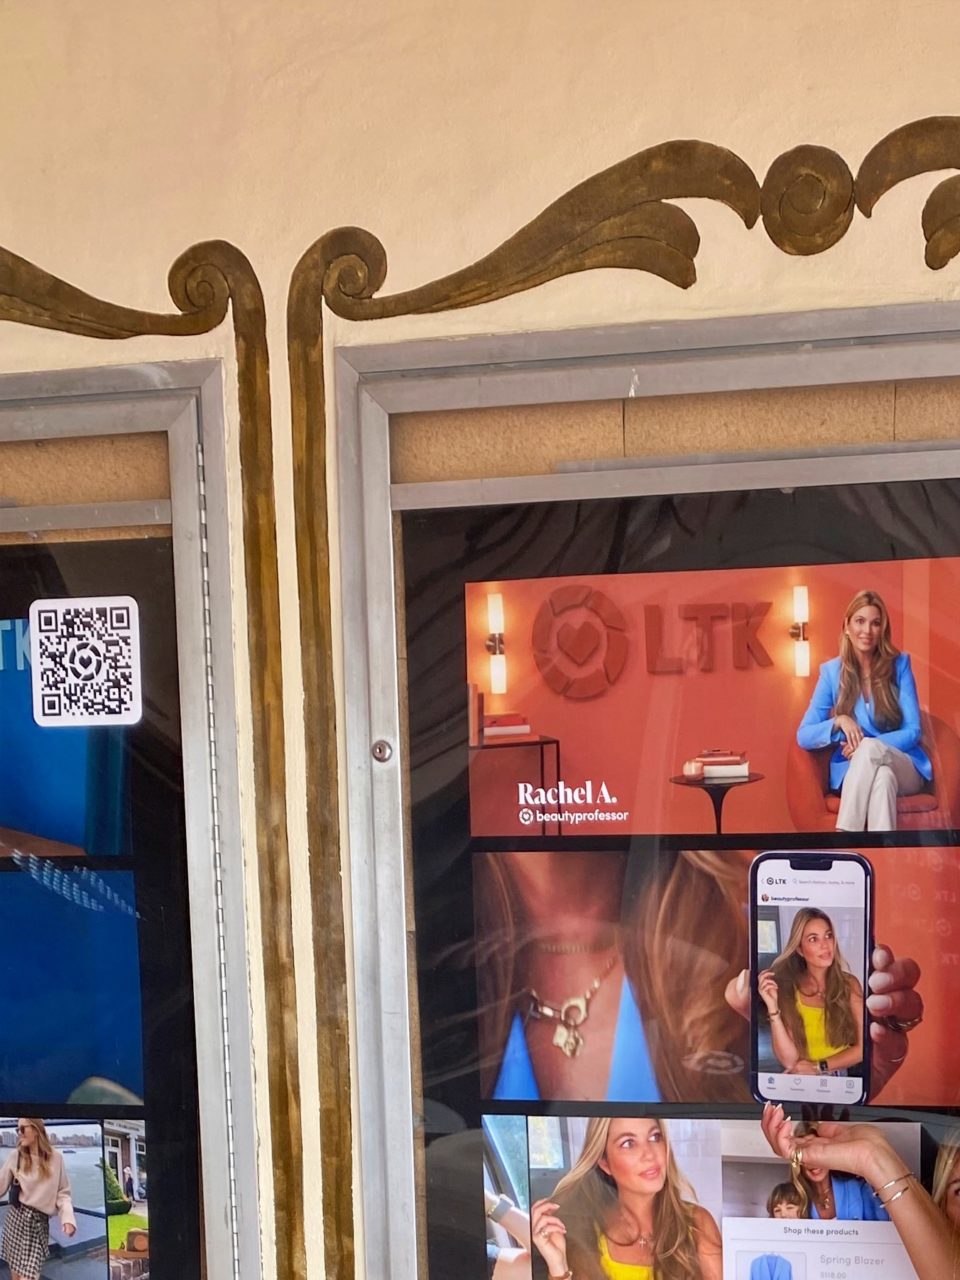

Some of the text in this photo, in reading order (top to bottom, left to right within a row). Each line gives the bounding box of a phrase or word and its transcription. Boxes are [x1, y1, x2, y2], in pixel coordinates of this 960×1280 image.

[644, 601, 774, 674] LTK
[517, 780, 618, 805] Rachel A.
[536, 809, 629, 825] beautyprofessor
[783, 1226, 859, 1236] Shop these products
[820, 1254, 885, 1267] Spring Blazer
